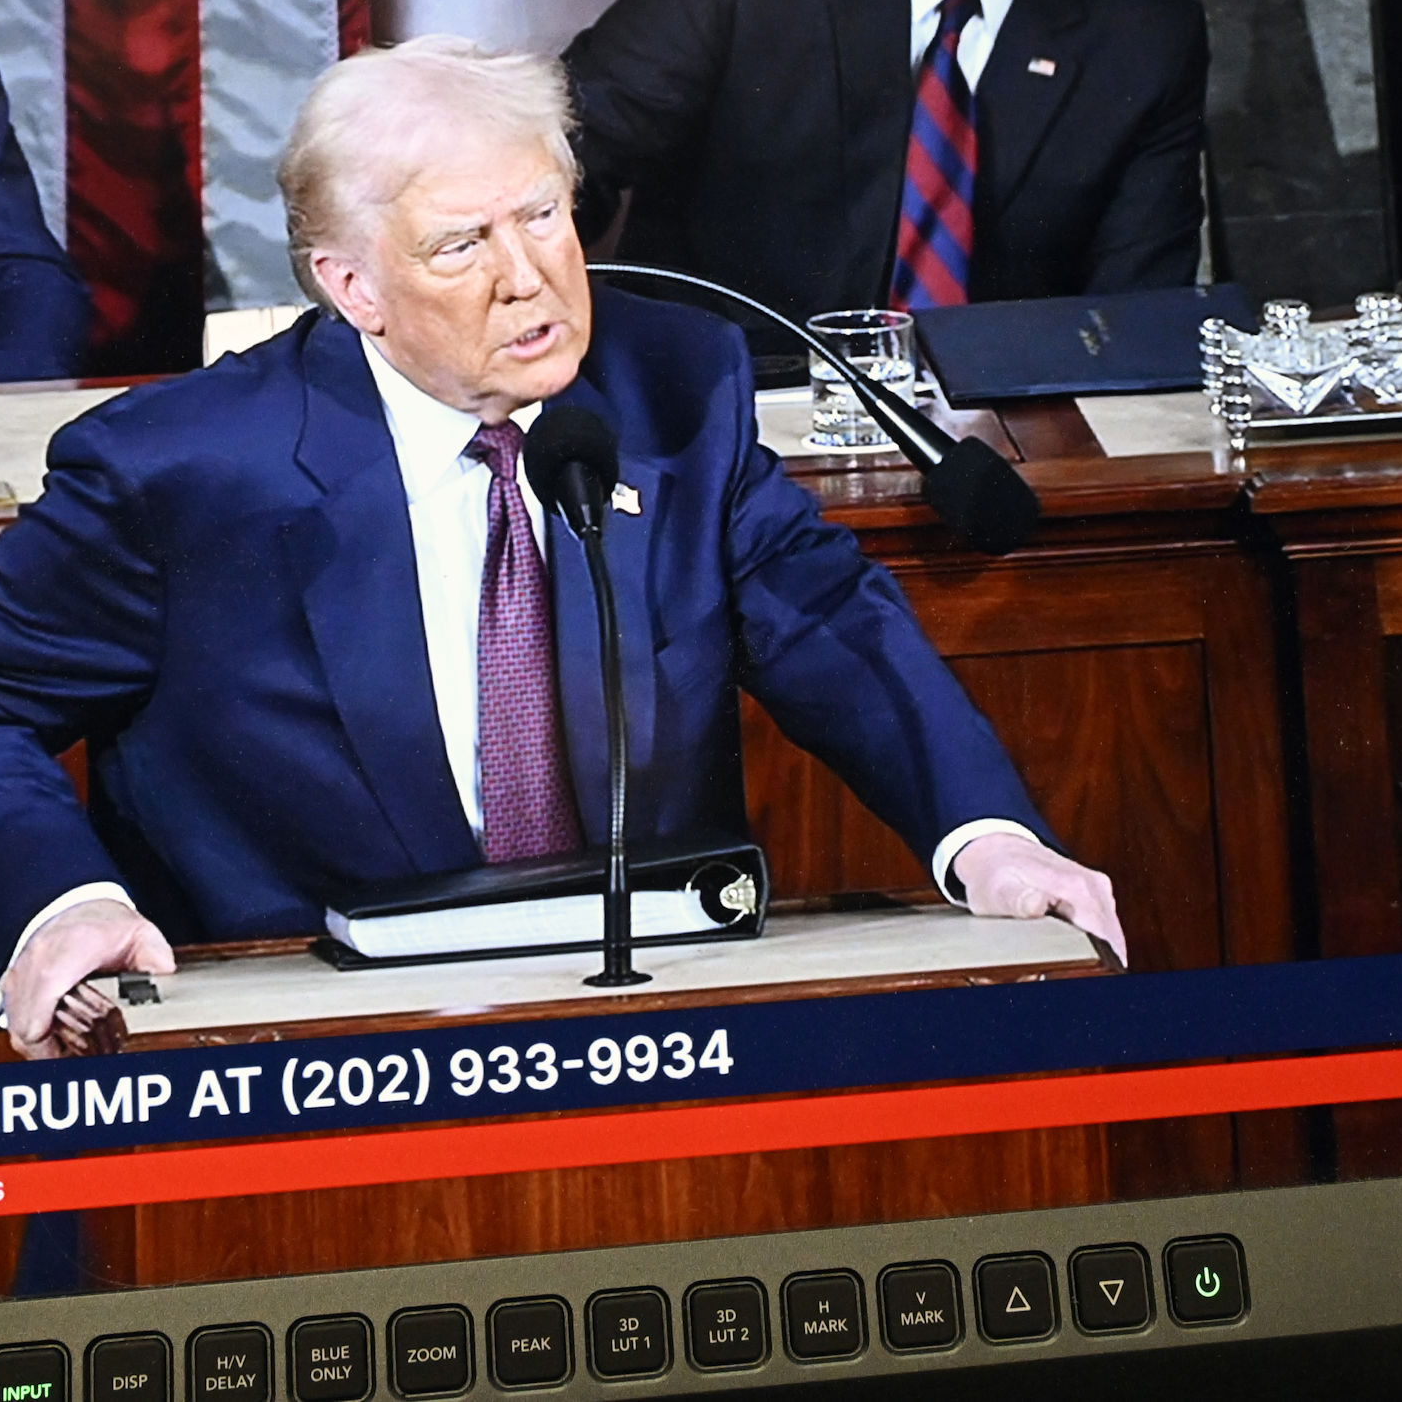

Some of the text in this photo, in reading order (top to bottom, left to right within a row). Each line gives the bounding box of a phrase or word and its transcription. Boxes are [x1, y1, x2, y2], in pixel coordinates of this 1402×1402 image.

[188, 1065, 263, 1118] AT
[281, 1047, 431, 1116] (202)
[449, 1028, 735, 1097] 933-9934
[915, 1291, 926, 1305] V
[818, 1300, 830, 1314] H
[619, 1317, 640, 1332] 3D
[716, 1308, 737, 1324] 3D
[900, 1309, 945, 1326] MARK
[804, 1318, 849, 1335] MARK
[611, 1335, 651, 1353] LUT 1
[708, 1327, 750, 1344] LUT 2
[511, 1336, 551, 1353] PEAK
[217, 1354, 246, 1370] H/V
[311, 1345, 350, 1362] BLUE
[407, 1345, 457, 1364] ZOOM
[310, 1364, 353, 1382] ONLY
[112, 1374, 148, 1391] DISP
[205, 1373, 257, 1392] DELAY
[2, 1382, 53, 1402] INPUT
